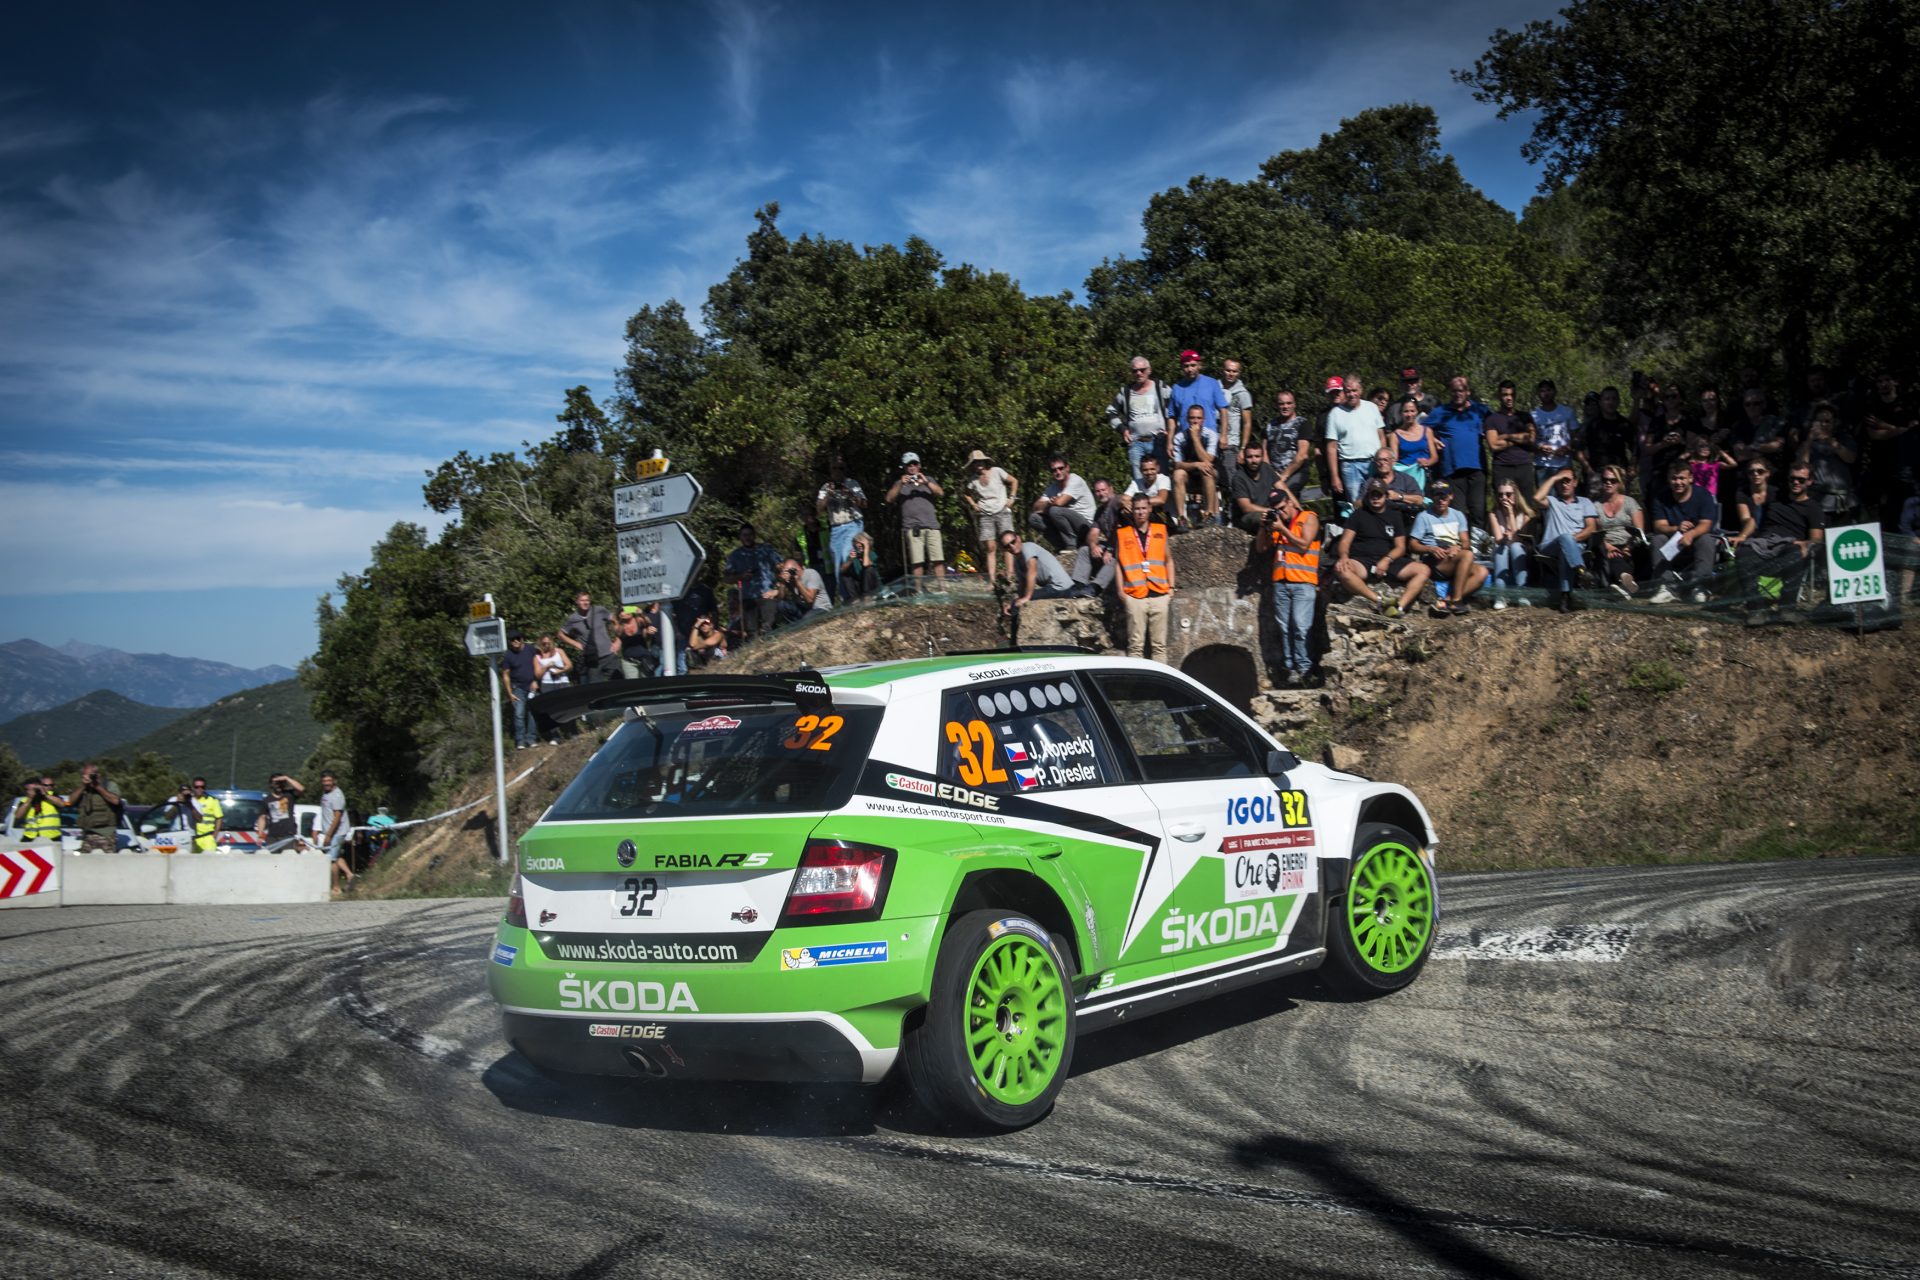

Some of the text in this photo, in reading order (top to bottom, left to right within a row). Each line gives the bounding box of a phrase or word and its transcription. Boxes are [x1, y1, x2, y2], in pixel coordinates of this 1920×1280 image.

[1833, 578, 1850, 598] ZP
[968, 668, 1010, 681] ŠKODA
[795, 683, 827, 695] ŠKODA
[784, 714, 844, 751] 32
[945, 719, 1009, 787] 32
[1037, 763, 1097, 786] P. Dresler
[898, 777, 1001, 811] Castrol EDGE
[866, 802, 1006, 824] www.skoda-motorsport.com
[1227, 791, 1308, 826] IGOL 32
[526, 852, 774, 870] ŠKODA FABIA R5
[1235, 852, 1309, 889] Che ENERGY
[1282, 871, 1305, 890] DRINK
[620, 878, 658, 917] 32
[1160, 903, 1279, 954] ŠKODA
[557, 939, 887, 961] www.skoda-auto.com MICHELIN
[559, 972, 700, 1012] ŠKODA
[596, 1024, 668, 1040] Castrol EDGE
